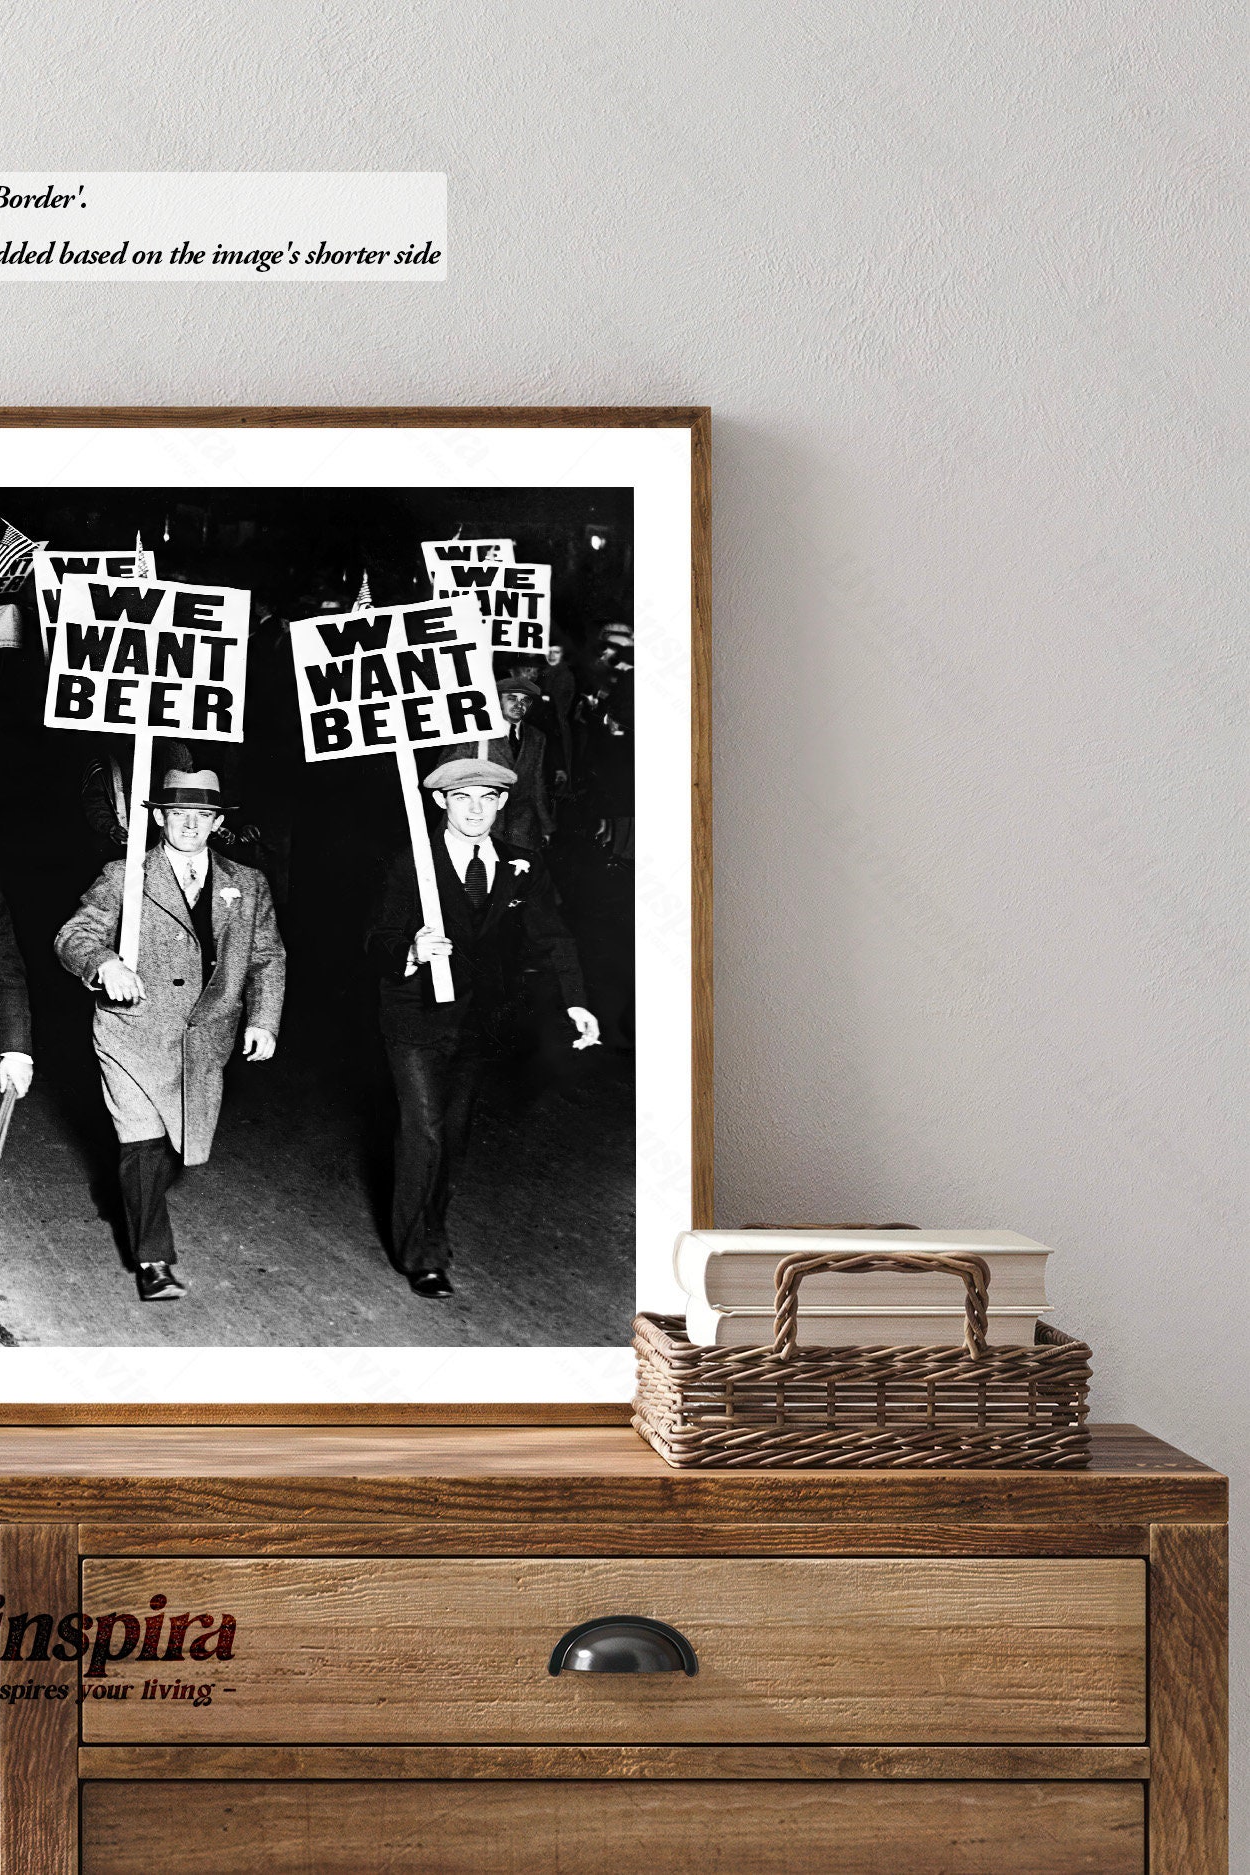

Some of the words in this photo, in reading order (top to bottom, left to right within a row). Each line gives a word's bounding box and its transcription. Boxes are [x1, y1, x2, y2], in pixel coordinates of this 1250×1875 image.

[87, 582, 225, 632] WE
[450, 565, 536, 590] WE
[65, 622, 239, 682] WANT
[315, 605, 458, 658] WE
[53, 673, 235, 734] BEER
[303, 642, 477, 707] WANT
[309, 690, 494, 755] BEER
